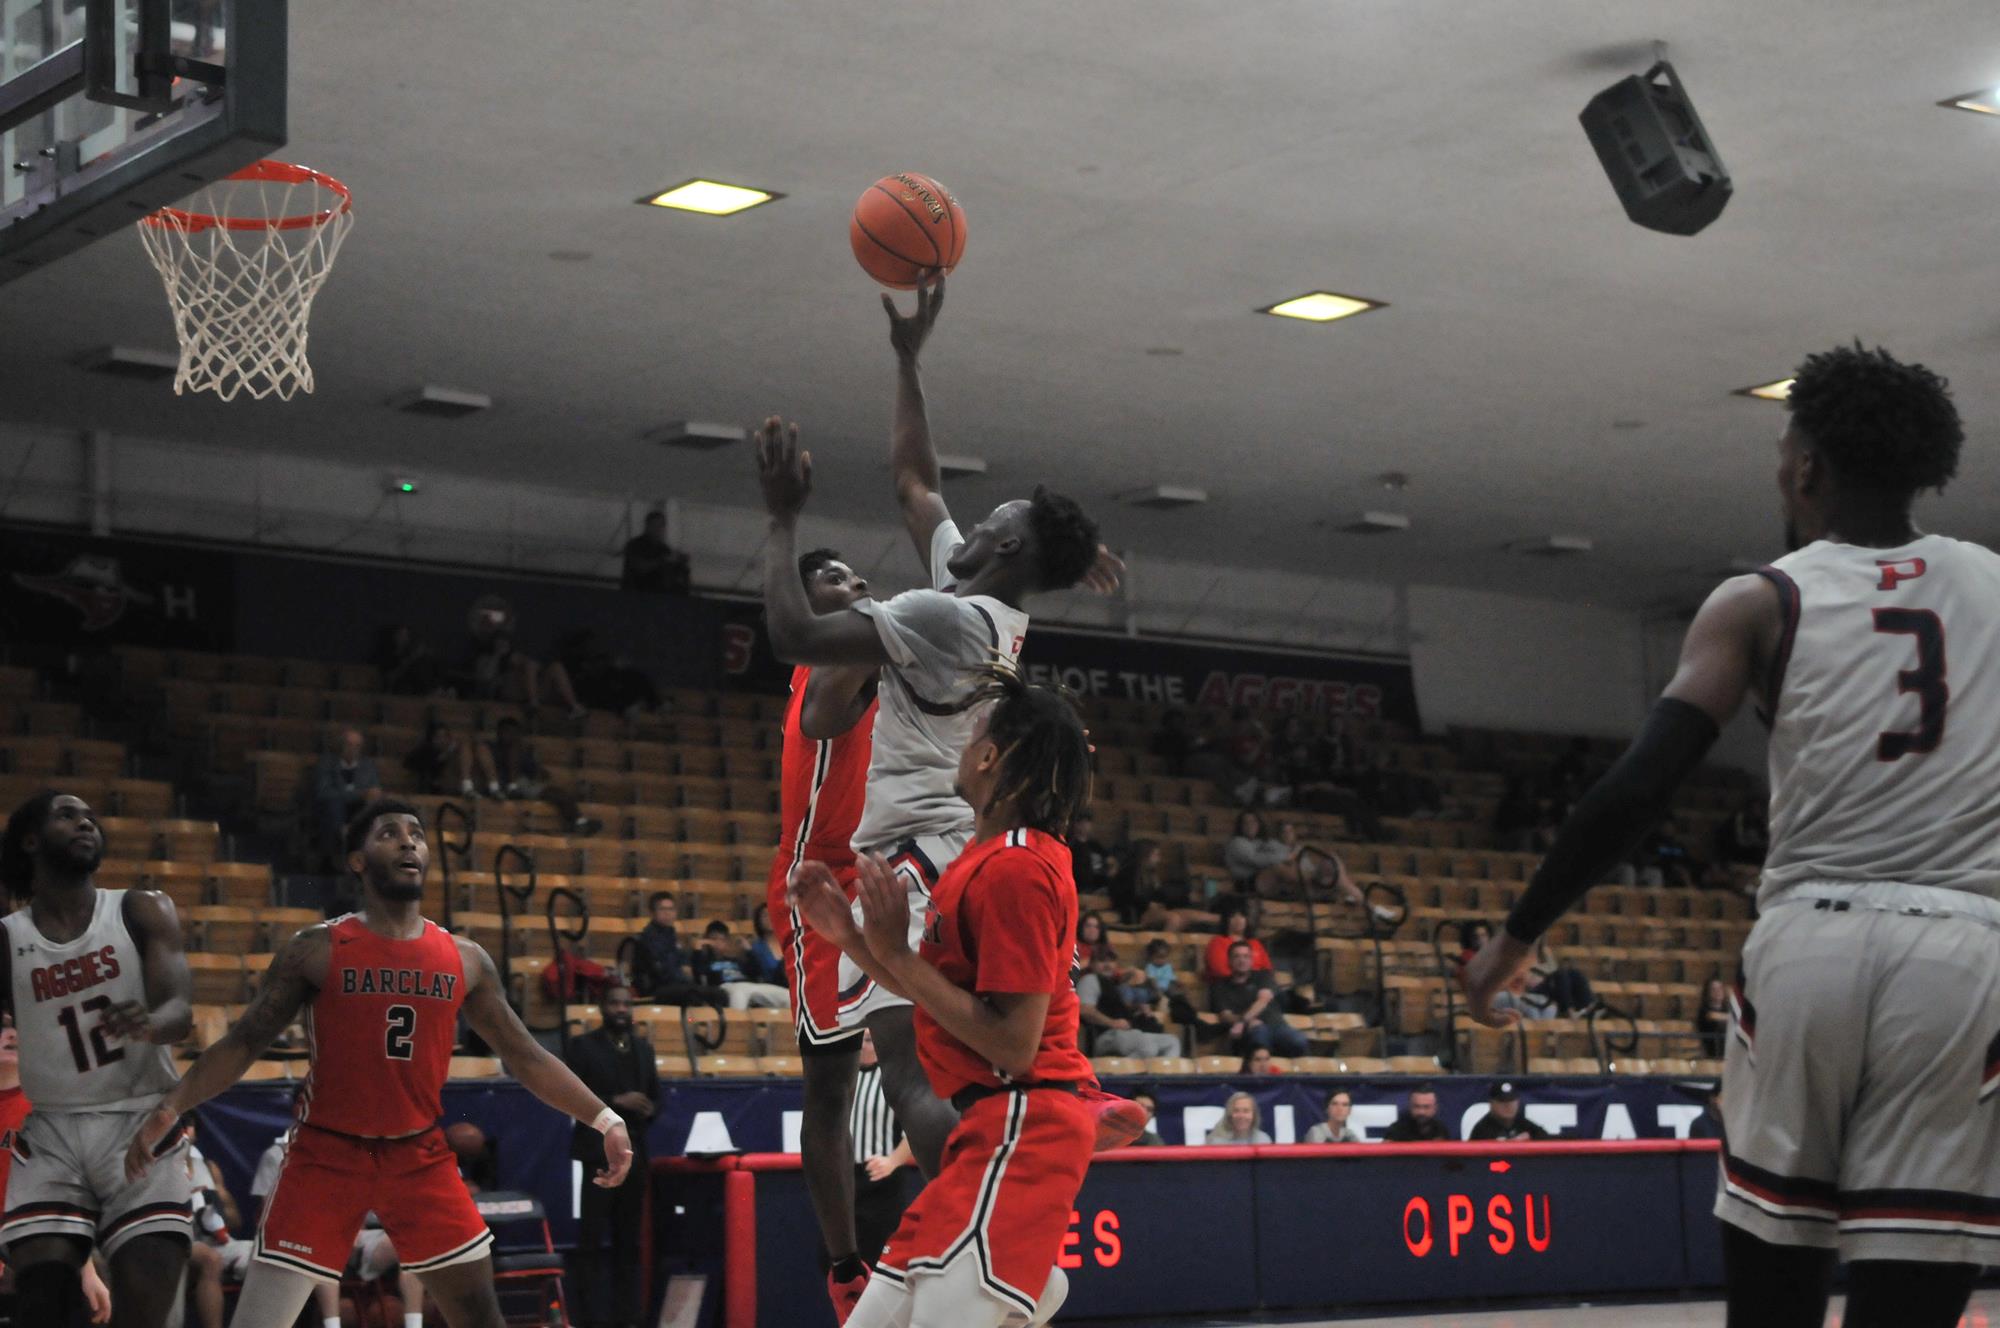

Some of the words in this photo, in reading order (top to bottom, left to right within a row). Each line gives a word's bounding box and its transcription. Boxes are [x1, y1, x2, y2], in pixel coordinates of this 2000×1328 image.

[1875, 557, 1927, 591] P
[1062, 666, 1109, 698] OF
[1118, 671, 1184, 706] THE
[1198, 671, 1383, 715] AGGIES
[1871, 607, 1949, 762] 3
[31, 945, 121, 1003] AGGIES
[342, 967, 457, 1002] BARCLAY
[57, 994, 126, 1074] 12
[385, 1004, 416, 1060] 2
[1403, 1194, 1551, 1257] OPSU
